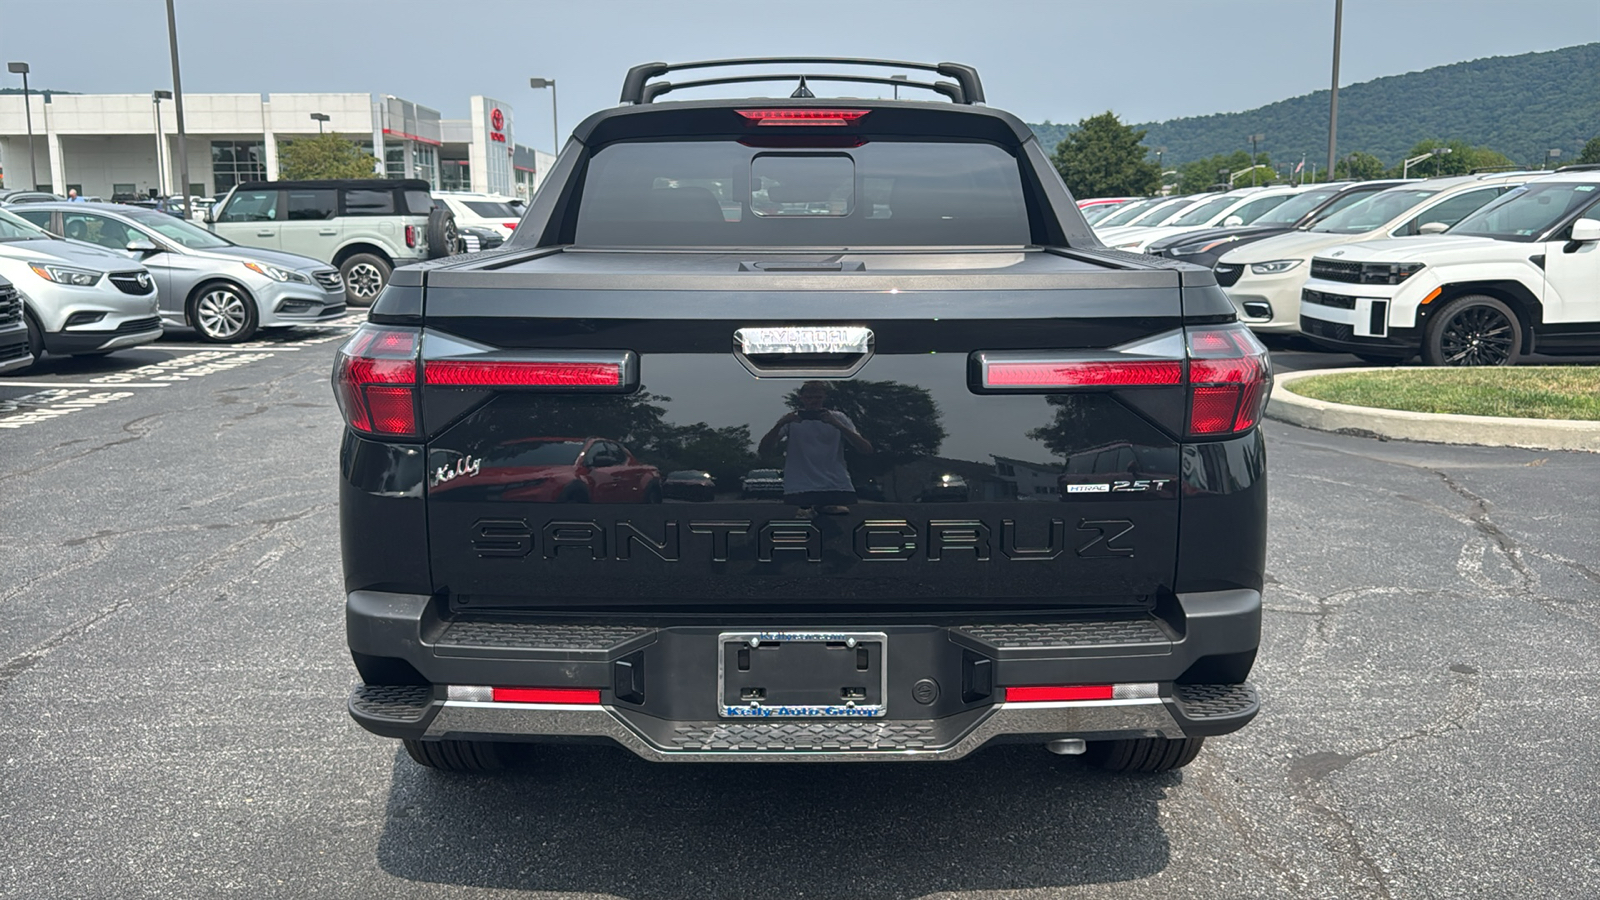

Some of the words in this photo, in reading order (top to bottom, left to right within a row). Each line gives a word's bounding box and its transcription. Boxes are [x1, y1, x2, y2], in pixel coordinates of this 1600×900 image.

[761, 330, 848, 343] HYUNDAI
[435, 454, 482, 486] Kelly
[471, 518, 822, 561] SANTA
[853, 518, 1135, 561] CRUZ
[727, 706, 772, 717] Kelly
[778, 706, 819, 716] Auto
[825, 706, 878, 717] Group
